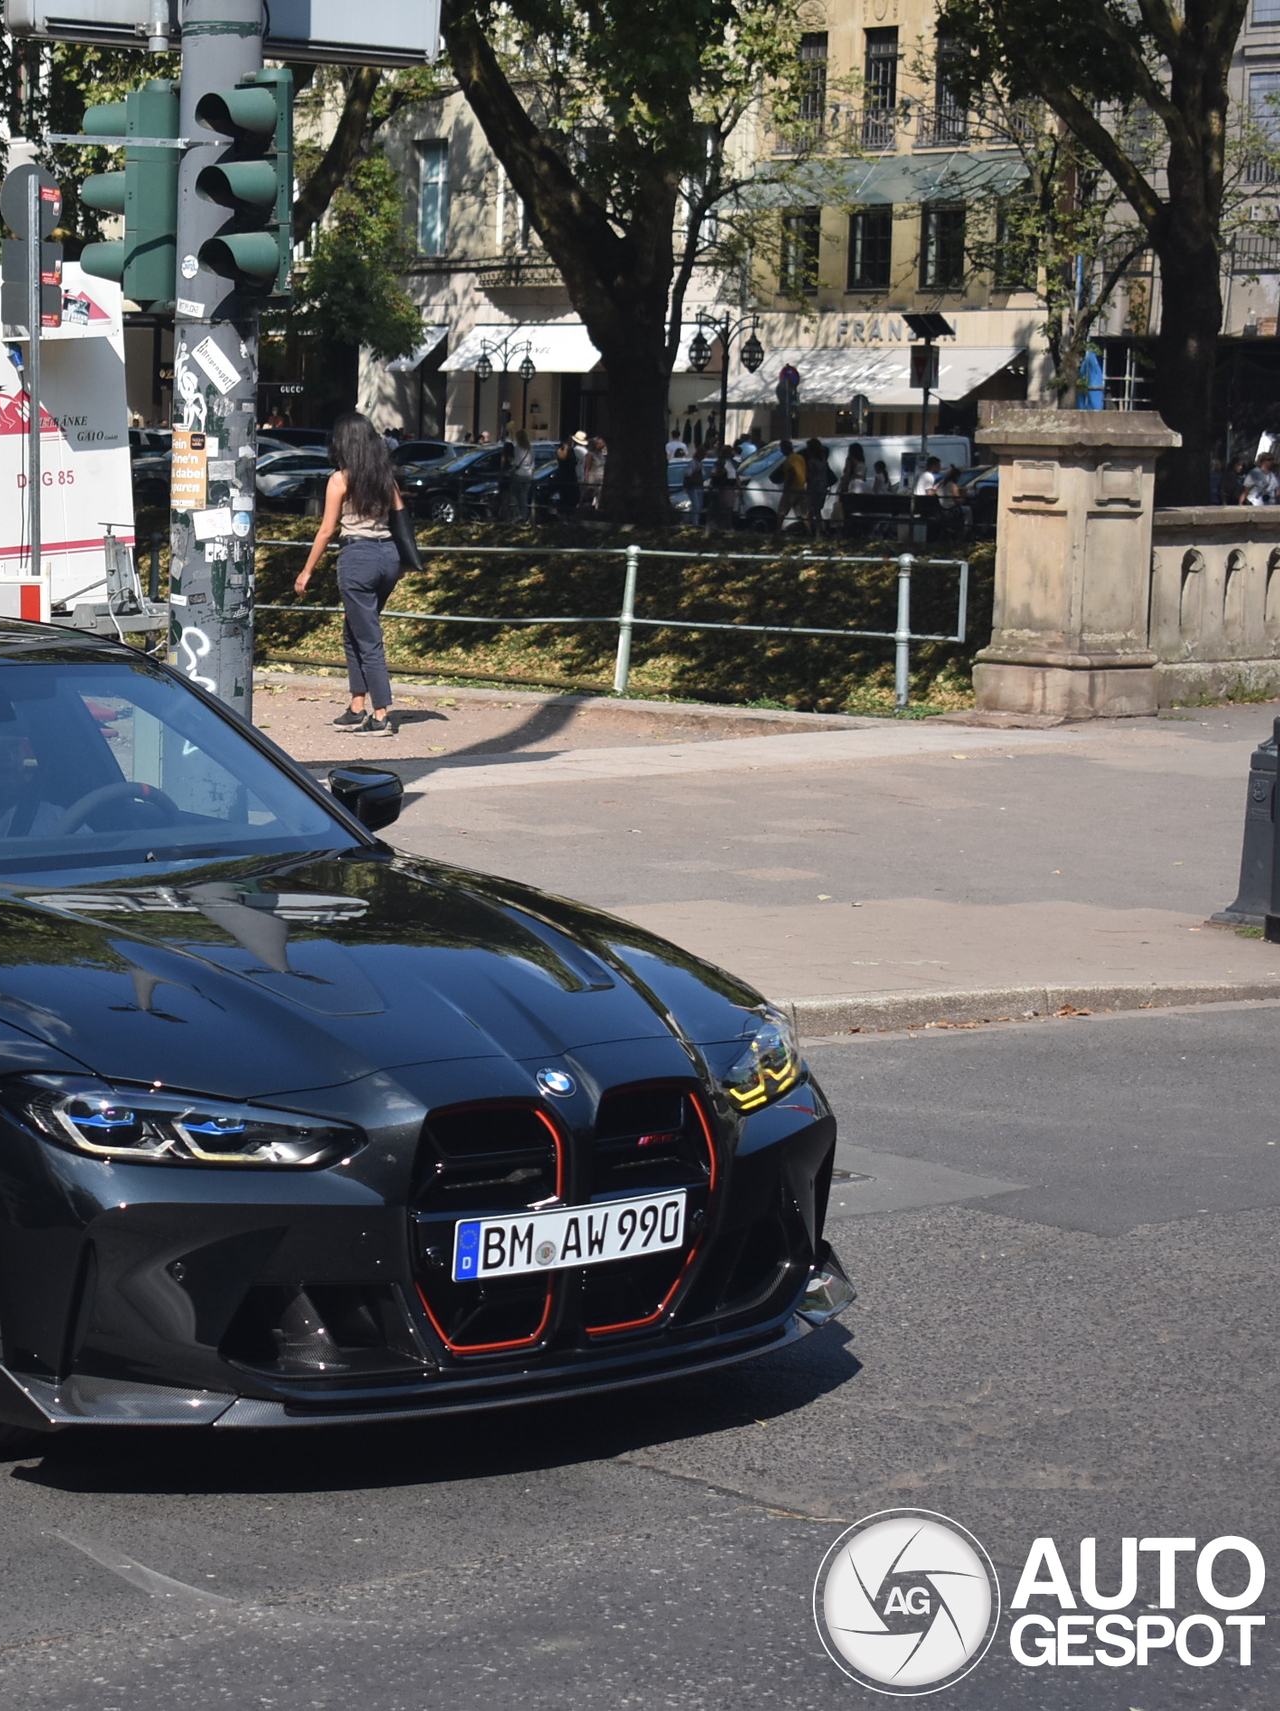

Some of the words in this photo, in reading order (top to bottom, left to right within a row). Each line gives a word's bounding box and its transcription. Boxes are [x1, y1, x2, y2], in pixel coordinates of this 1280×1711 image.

[836, 319, 957, 342] FRANZN
[40, 415, 88, 427] ETRÄNKE
[77, 431, 104, 442] GATO
[58, 470, 74, 485] 85
[176, 467, 205, 479] dabei
[463, 1256, 472, 1269] D
[482, 1222, 535, 1271] BM
[561, 1211, 608, 1261] AW
[617, 1200, 680, 1251] 990
